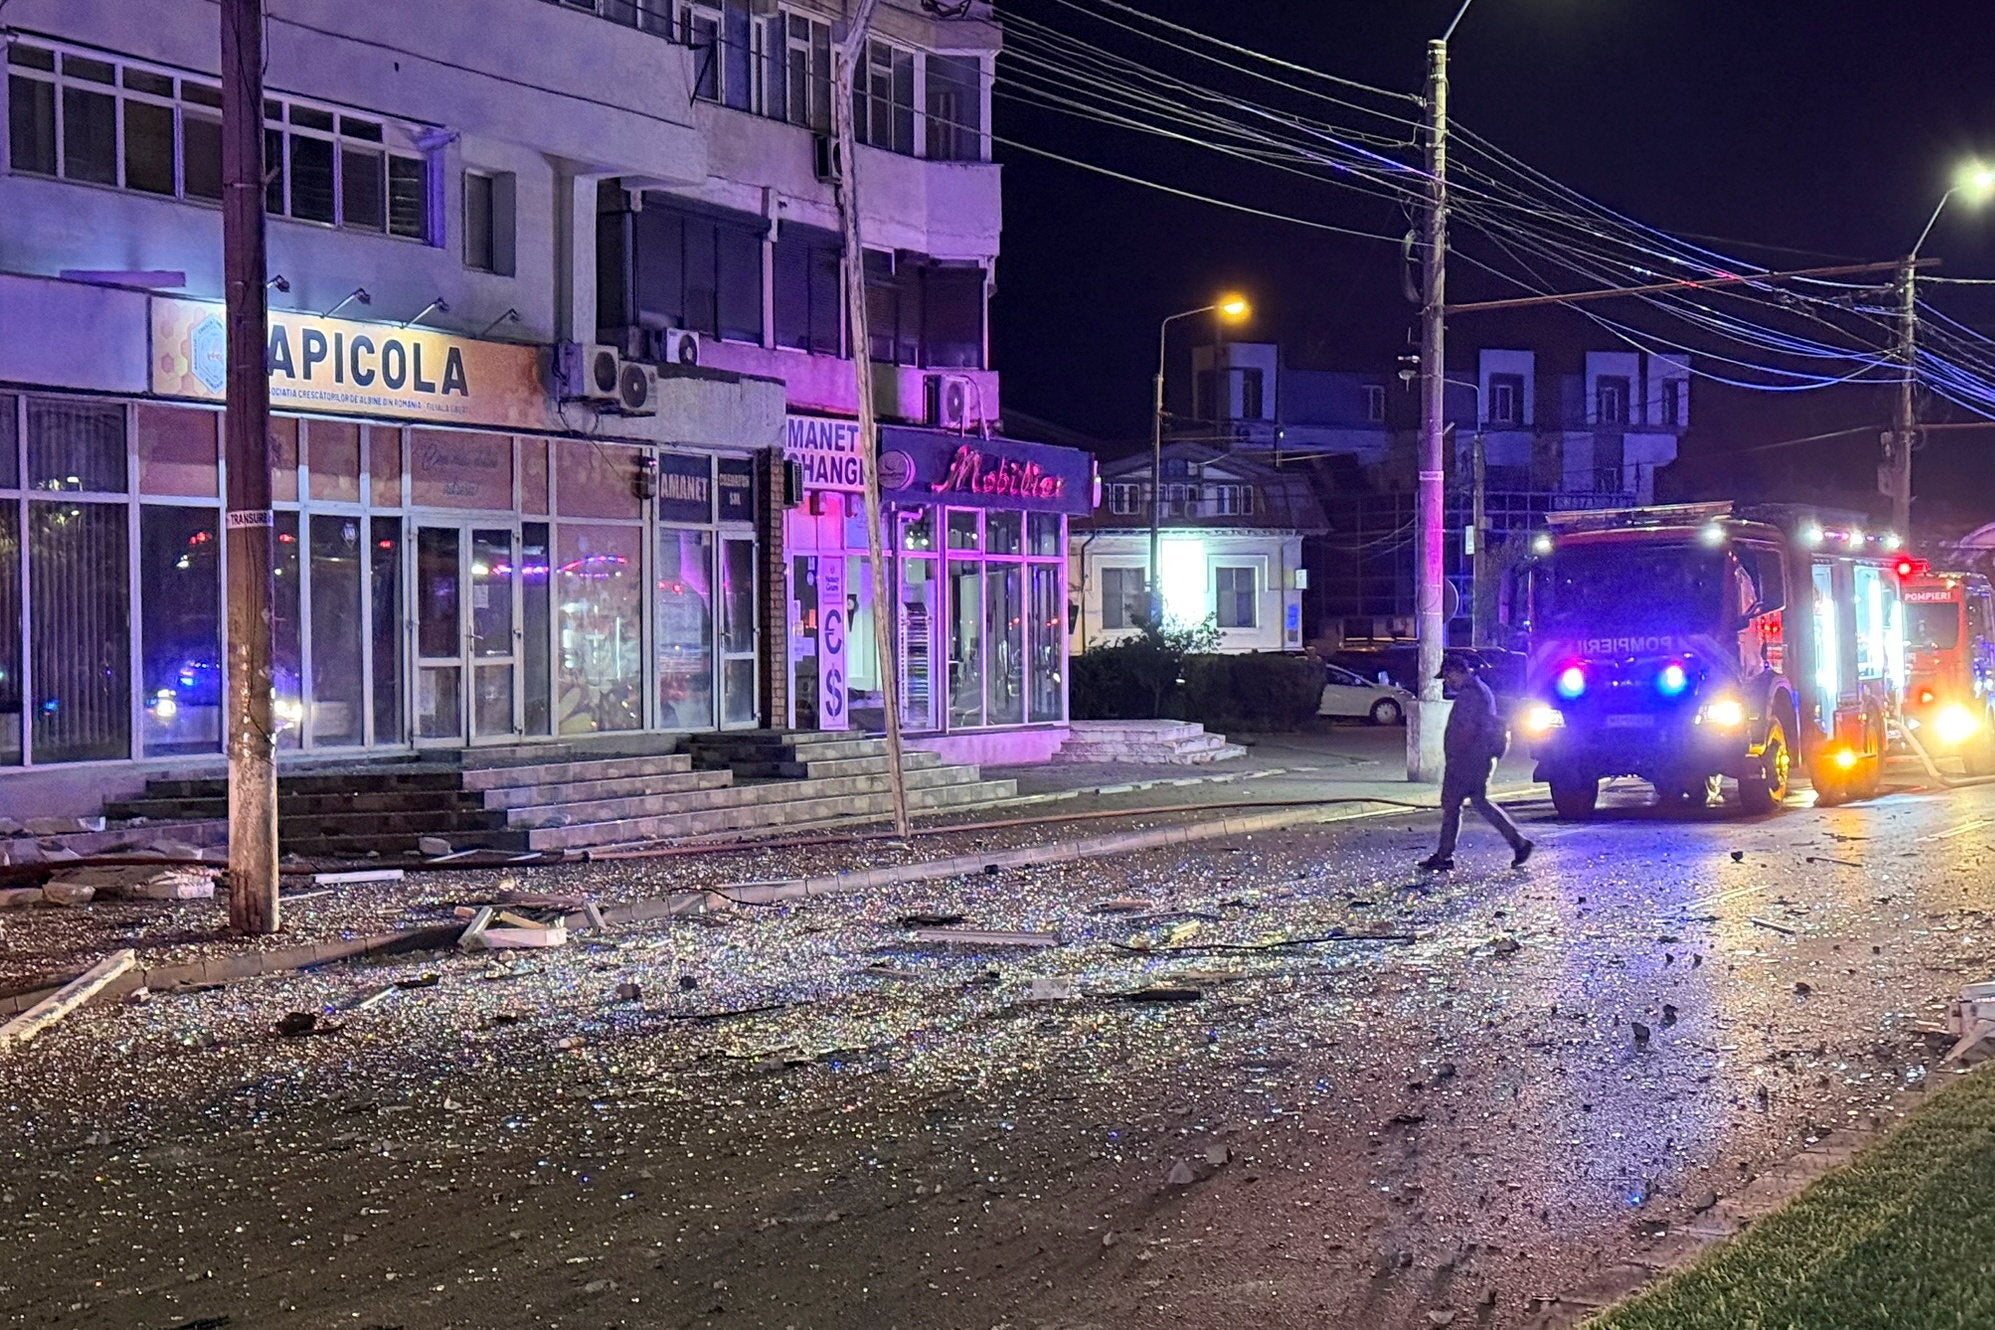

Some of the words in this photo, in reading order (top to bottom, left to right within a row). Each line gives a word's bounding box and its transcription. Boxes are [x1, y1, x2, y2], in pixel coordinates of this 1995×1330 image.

[268, 325, 469, 396] APICOLA
[660, 473, 708, 502] AMANET
[1904, 591, 1952, 601] POMPIERI
